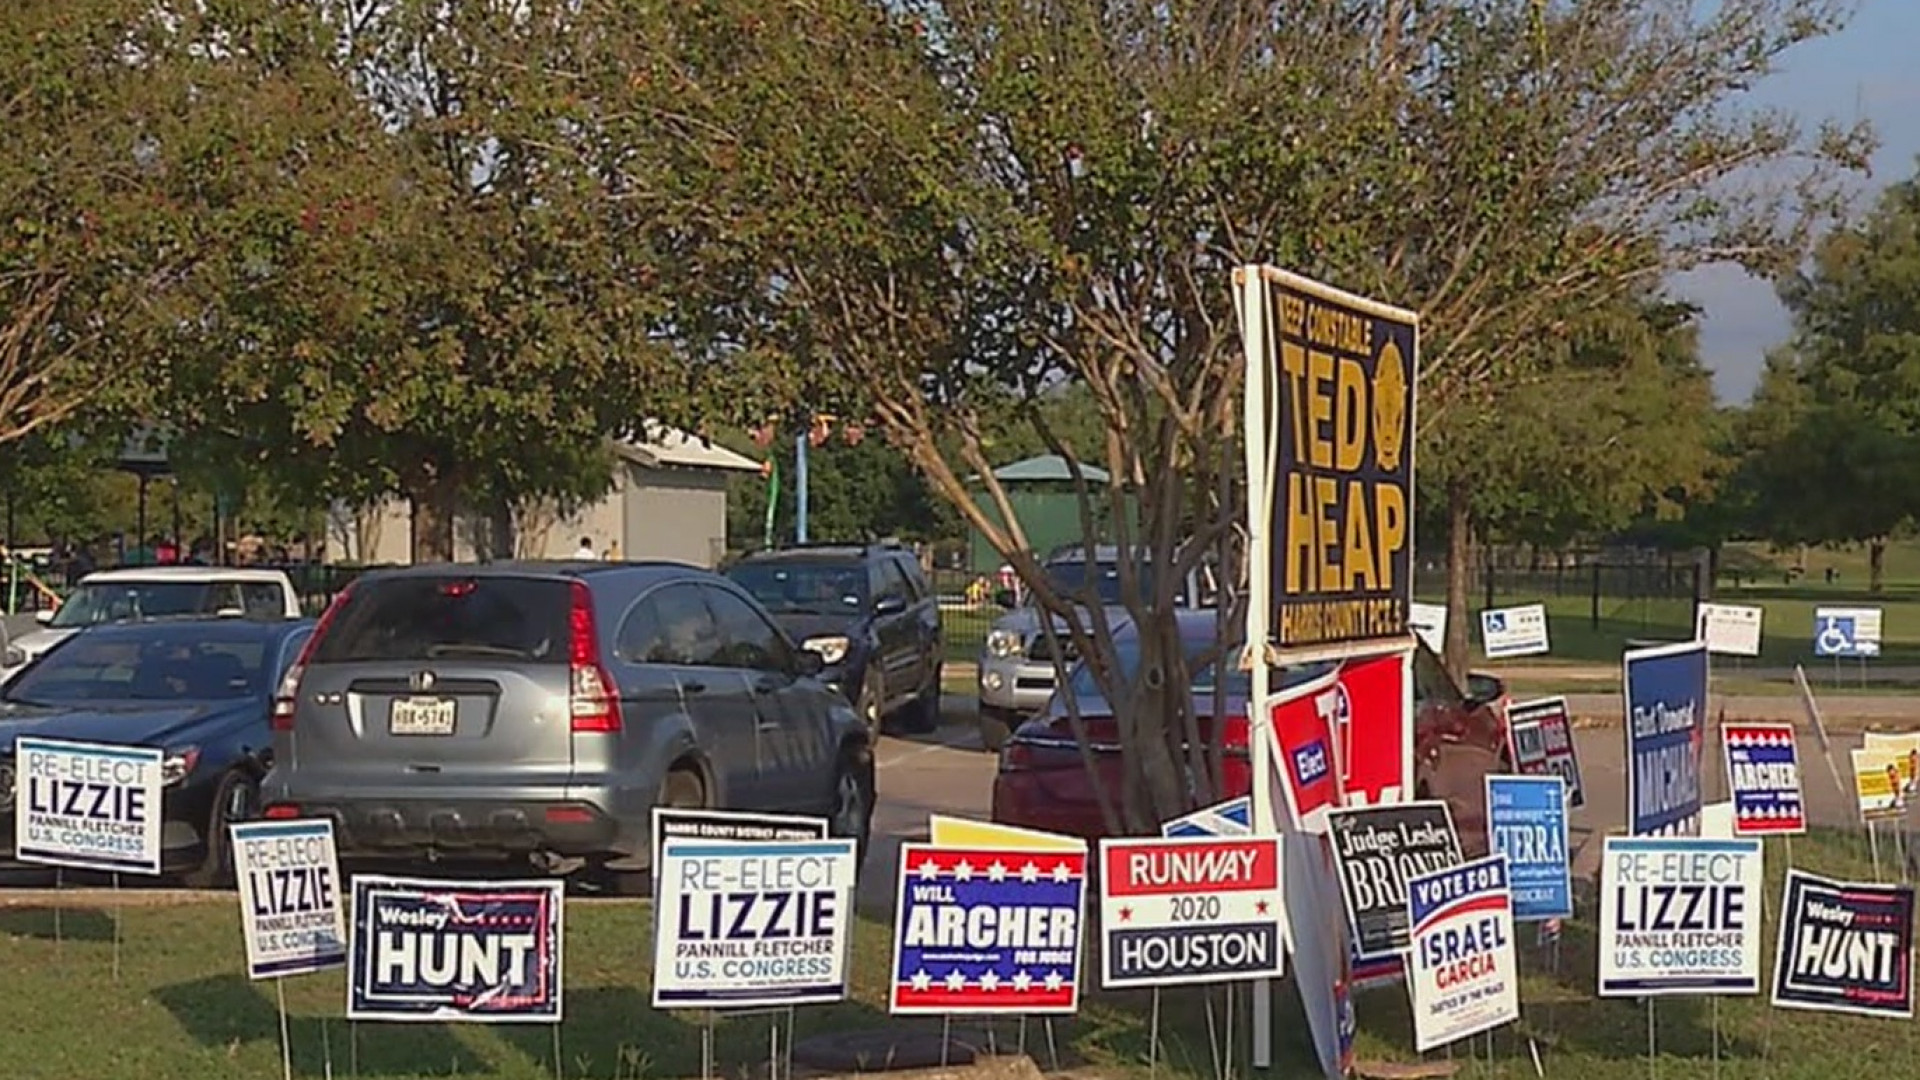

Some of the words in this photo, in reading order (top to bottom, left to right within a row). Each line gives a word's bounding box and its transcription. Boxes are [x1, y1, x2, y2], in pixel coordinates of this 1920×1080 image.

[1308, 302, 1372, 356] CONSTABLE
[1281, 341, 1366, 470] TED
[1286, 472, 1406, 594] HEAP
[1281, 601, 1322, 643] HARRIS
[1323, 599, 1367, 639] COUNTY
[29, 752, 146, 784] RE-ELECT
[1734, 762, 1798, 791] ARCHER
[30, 776, 146, 822] LIZZIE
[28, 827, 57, 843] U.S.
[61, 832, 144, 851] CONGRESS
[29, 814, 78, 831] PANNILL
[82, 818, 145, 836] FLETCHER
[1343, 826, 1398, 857] Judge
[1399, 821, 1449, 852] Lesley
[246, 836, 326, 868] RE-ELECT
[1130, 850, 1257, 886] RUNWAY
[1616, 853, 1746, 883] RE-ELECT
[680, 857, 837, 890] RE-ELECT
[1417, 876, 1464, 905] VOTE
[1467, 864, 1502, 887] FOR
[249, 867, 334, 916] LIZZIE
[913, 885, 956, 903] WILL
[1170, 895, 1221, 921] 2020
[1616, 885, 1744, 931] LIZZIE
[379, 905, 450, 929] Wesley
[679, 891, 836, 940] LIZZIE
[905, 904, 1077, 948] ARCHER
[1807, 901, 1855, 927] Wesley
[258, 934, 280, 951] U.S.
[676, 943, 748, 958] PANNILL
[753, 940, 834, 956] FLETCHER
[1121, 931, 1267, 971] HOUSTON
[1419, 916, 1507, 970] ISRAEL
[1615, 934, 1668, 948] PANNILL
[1671, 932, 1744, 948] FLETCHER
[1797, 924, 1901, 983] HUNT
[377, 932, 536, 986] HUNT
[675, 961, 716, 979] U.S.
[723, 957, 832, 977] CONGRESS
[1435, 954, 1497, 989] GARCIA
[1614, 952, 1645, 968] U.S.
[1650, 950, 1743, 968] CONGRESS
